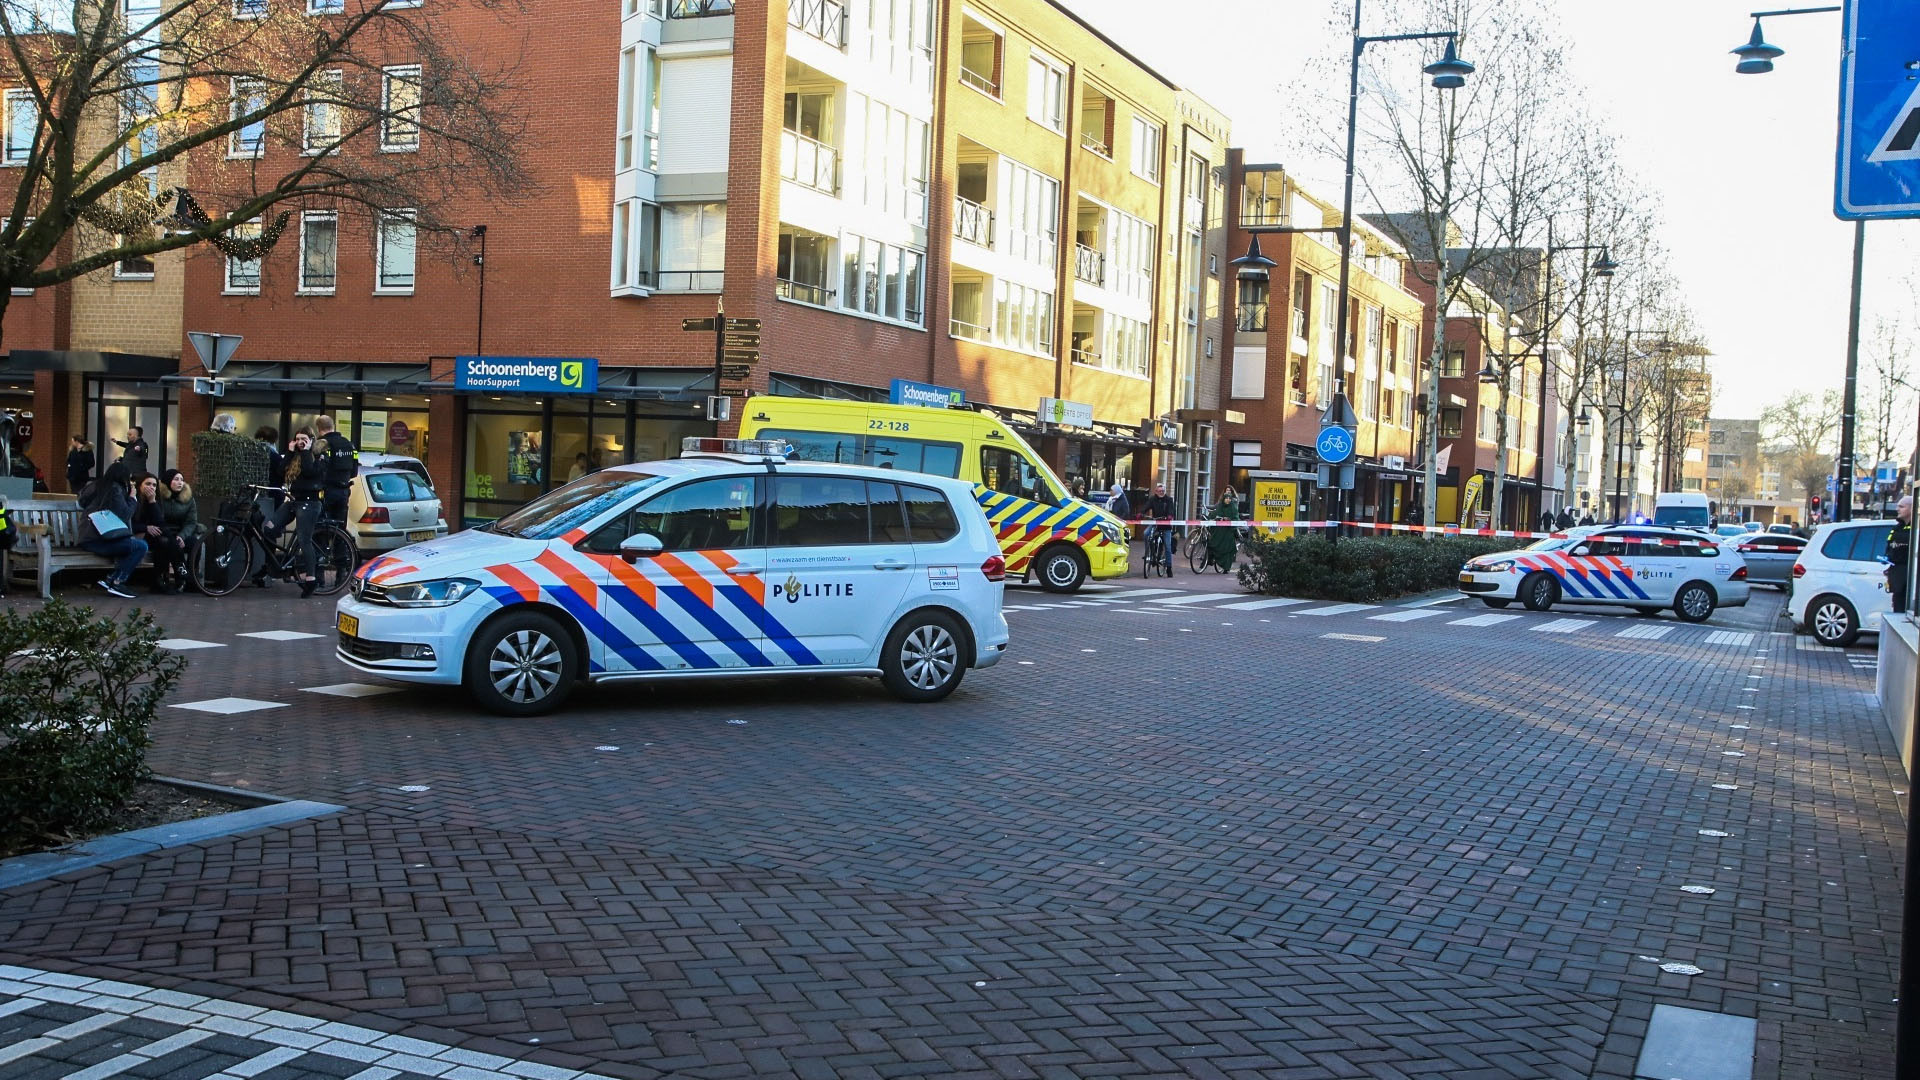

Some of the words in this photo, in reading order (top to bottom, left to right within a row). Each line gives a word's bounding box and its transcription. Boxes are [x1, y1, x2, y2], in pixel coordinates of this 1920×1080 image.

[467, 360, 558, 381] Schoonenberg
[467, 377, 520, 388] HoorSupport
[903, 384, 949, 408] Schoonenberg
[18, 425, 31, 436] CZ
[869, 419, 909, 431] 22-128
[1154, 421, 1176, 440] MyCom
[1636, 570, 1673, 580] POLITIE
[773, 583, 854, 604] POLITIE
